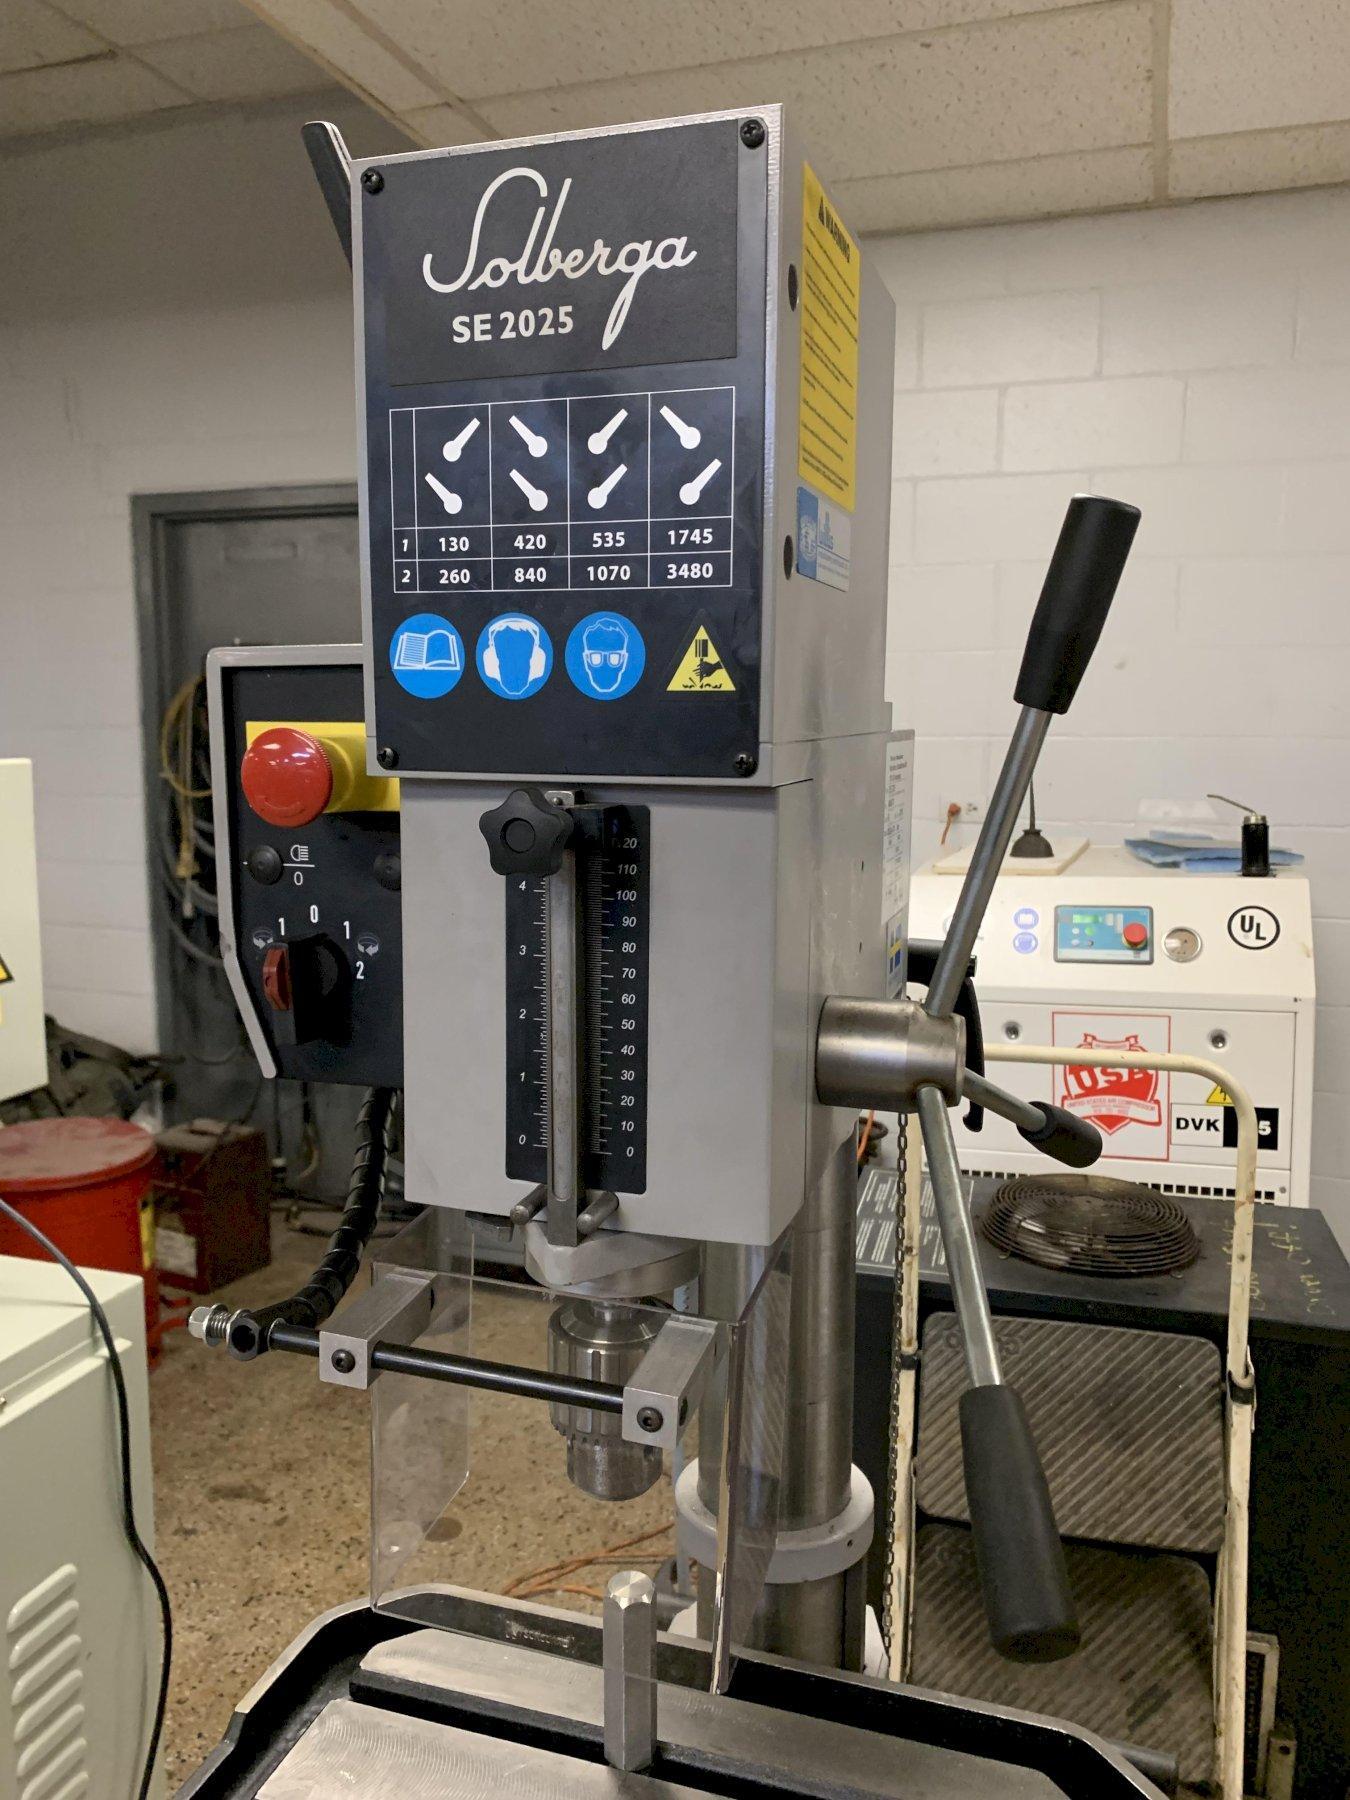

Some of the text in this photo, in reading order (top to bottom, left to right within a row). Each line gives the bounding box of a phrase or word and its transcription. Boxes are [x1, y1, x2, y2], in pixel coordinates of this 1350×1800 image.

[422, 166, 697, 351] Solberga
[453, 306, 573, 343] SE 2025
[402, 528, 713, 551] 1 130 420 535 1745
[402, 563, 713, 583] 2 260 840 1070 3480
[620, 837, 638, 849] 20
[619, 864, 637, 875] 110
[294, 871, 303, 885] 0
[518, 881, 526, 891] 4
[617, 890, 637, 901] 100
[310, 905, 318, 923] 0
[278, 918, 285, 935] 1
[622, 916, 636, 927] 90
[343, 921, 349, 939] 1
[1240, 915, 1267, 941] UL
[518, 945, 526, 955] 3
[622, 942, 636, 953] 80
[356, 961, 364, 979] 2
[623, 968, 636, 979] 70
[622, 994, 635, 1004] 60
[518, 1009, 526, 1018] 2
[621, 1019, 635, 1030] 50
[621, 1045, 635, 1055] 40
[519, 1072, 525, 1081] 1
[621, 1070, 634, 1081] 30
[621, 1095, 634, 1106] 20
[621, 1121, 634, 1131] 10
[1176, 1117, 1220, 1132] DVK
[518, 1135, 526, 1144] 0
[626, 1147, 634, 1157] 0
